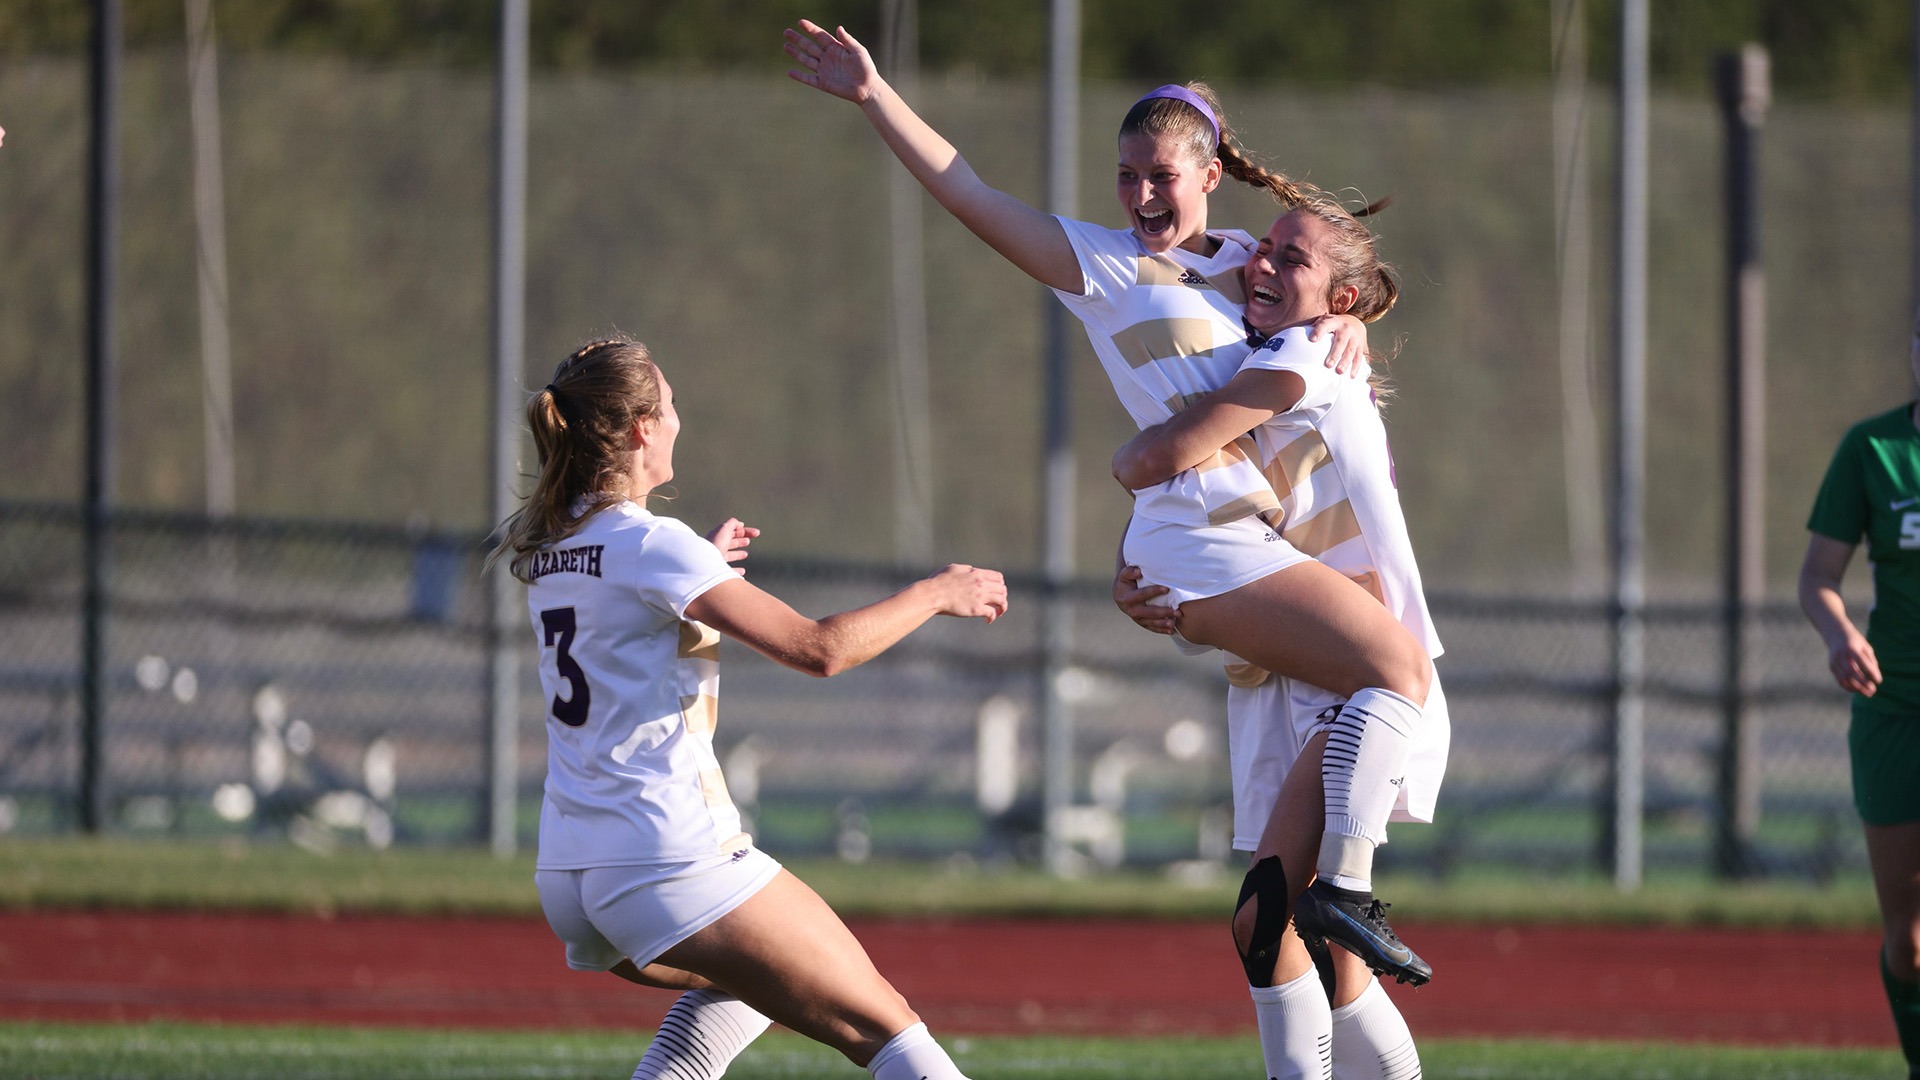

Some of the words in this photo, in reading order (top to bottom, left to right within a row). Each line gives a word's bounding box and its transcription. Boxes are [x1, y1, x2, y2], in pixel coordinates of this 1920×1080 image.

[1178, 276, 1208, 285] adida
[528, 544, 605, 580] AZARETH
[540, 605, 591, 729] 3
